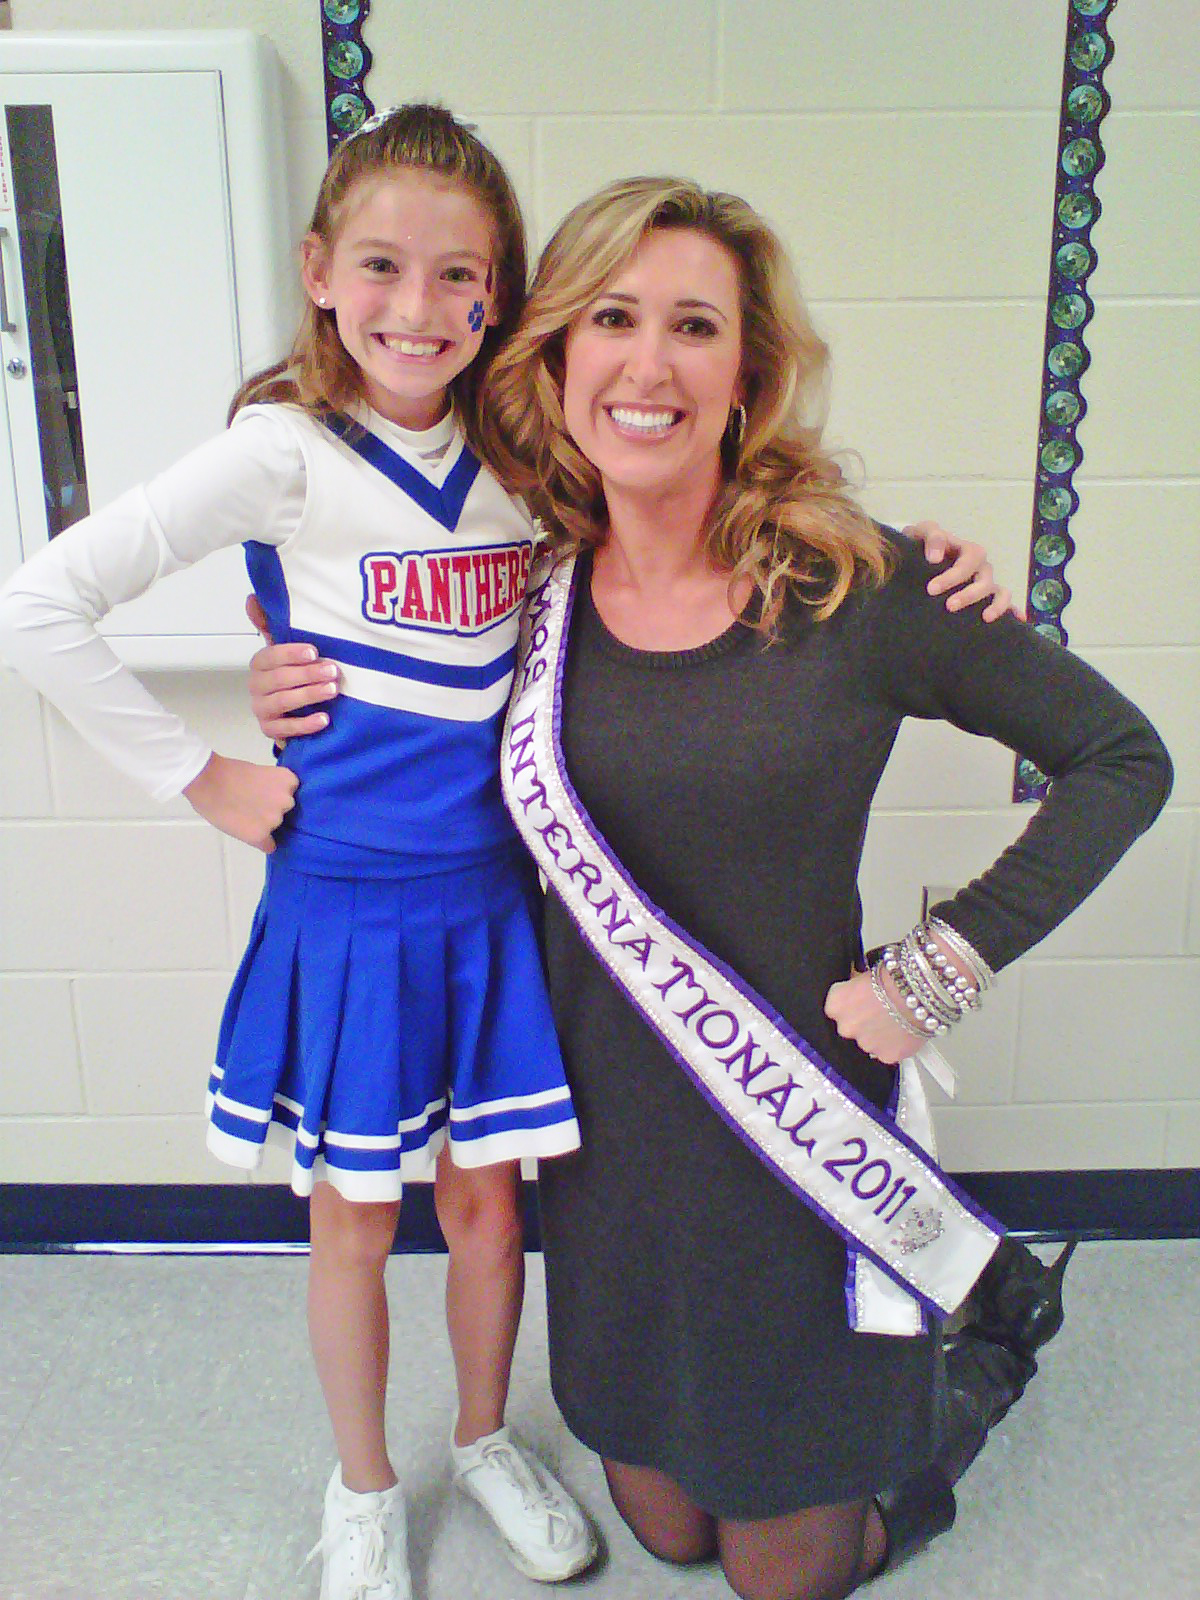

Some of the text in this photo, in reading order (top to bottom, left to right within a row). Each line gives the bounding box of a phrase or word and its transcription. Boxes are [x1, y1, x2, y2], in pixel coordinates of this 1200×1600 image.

[369, 546, 531, 628] PANTHERS
[509, 707, 826, 1159] INTERNATIONAL
[822, 1137, 918, 1225] 2011
